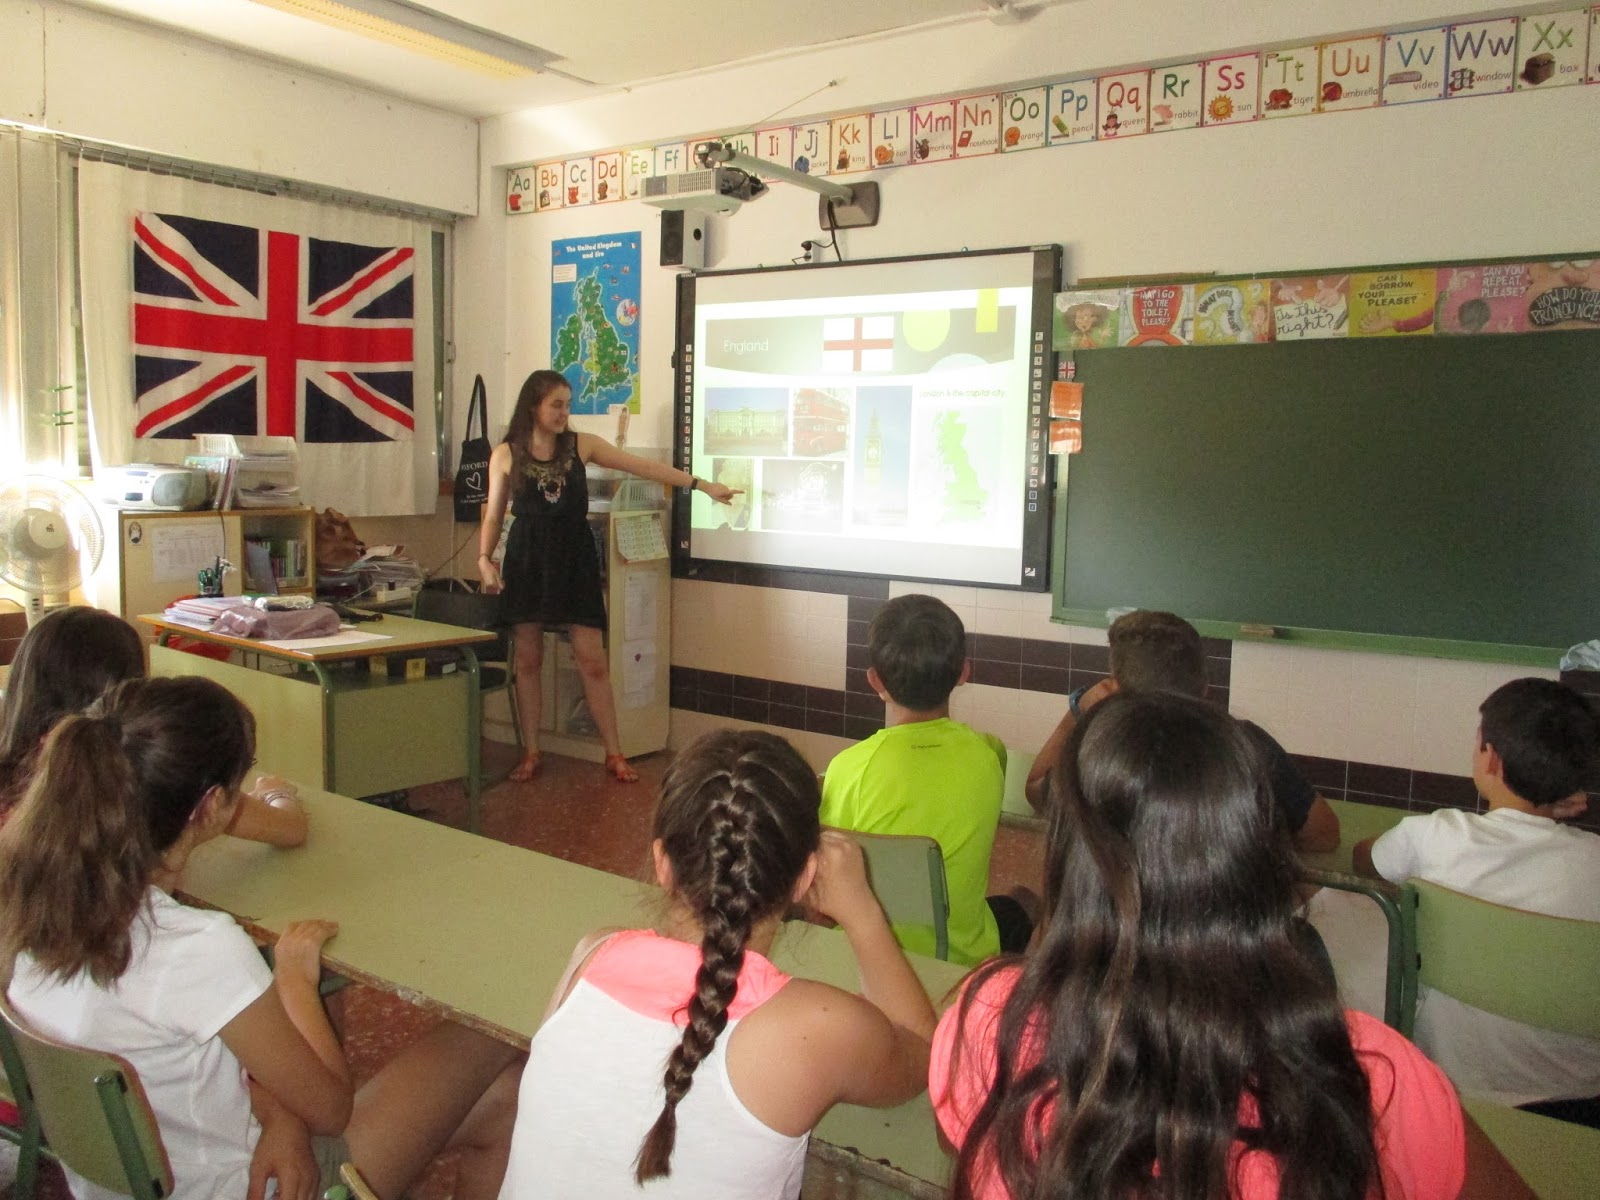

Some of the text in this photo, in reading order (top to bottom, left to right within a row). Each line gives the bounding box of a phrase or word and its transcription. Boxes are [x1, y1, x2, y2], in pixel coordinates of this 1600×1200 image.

[1532, 20, 1573, 51] Xx
[1397, 38, 1435, 68] Vv
[1452, 29, 1514, 61] Ww
[1277, 56, 1304, 84] Tt
[1332, 48, 1370, 76] Uu
[1559, 63, 1579, 75] box
[1163, 73, 1190, 99] Rr
[1217, 65, 1245, 91] Ss
[1413, 79, 1439, 91] video
[1475, 71, 1512, 83] window
[1106, 81, 1142, 113] Qq
[1293, 95, 1315, 108] tiger
[1342, 87, 1378, 99] umbrella
[1009, 96, 1040, 122] Oo
[1061, 89, 1088, 121] Pp
[1237, 103, 1252, 112] sun
[963, 104, 992, 128] Nn
[1122, 117, 1146, 129] queen
[1174, 109, 1199, 120] rabbit
[883, 116, 899, 141] Ll
[914, 111, 951, 137] Mm
[1071, 123, 1094, 136] pencil
[804, 129, 819, 159] Jj
[838, 124, 861, 146] Kk
[969, 137, 999, 149] notebook
[1020, 130, 1044, 142] orange
[769, 135, 779, 156] Ii
[928, 143, 953, 153] monkey
[631, 156, 648, 175] Ee
[664, 148, 680, 171] Ff
[809, 160, 829, 172] jacket
[852, 154, 865, 165] king
[541, 169, 558, 188] Bb
[570, 164, 587, 183] Cc
[599, 159, 618, 180] Dd
[512, 174, 531, 192] Aa
[577, 244, 596, 252] United
[597, 241, 622, 250] Kingdom
[1376, 275, 1397, 283] CAN
[1483, 266, 1525, 276] CAN YOU
[1140, 289, 1157, 300] MAY
[1161, 289, 1175, 299] GO
[1358, 290, 1385, 300] YOUR
[1369, 281, 1413, 291] BORROW
[1481, 287, 1526, 299] PLEASE?
[1143, 299, 1169, 308] TO THE
[1198, 289, 1234, 314] WHAT DOES
[1367, 296, 1417, 307] PLEASE?
[1536, 287, 1600, 309] HOW DO YOU
[1276, 302, 1328, 322] Is this
[1142, 317, 1170, 326] PLEASE?
[1277, 313, 1334, 337] right?
[723, 338, 769, 355] England
